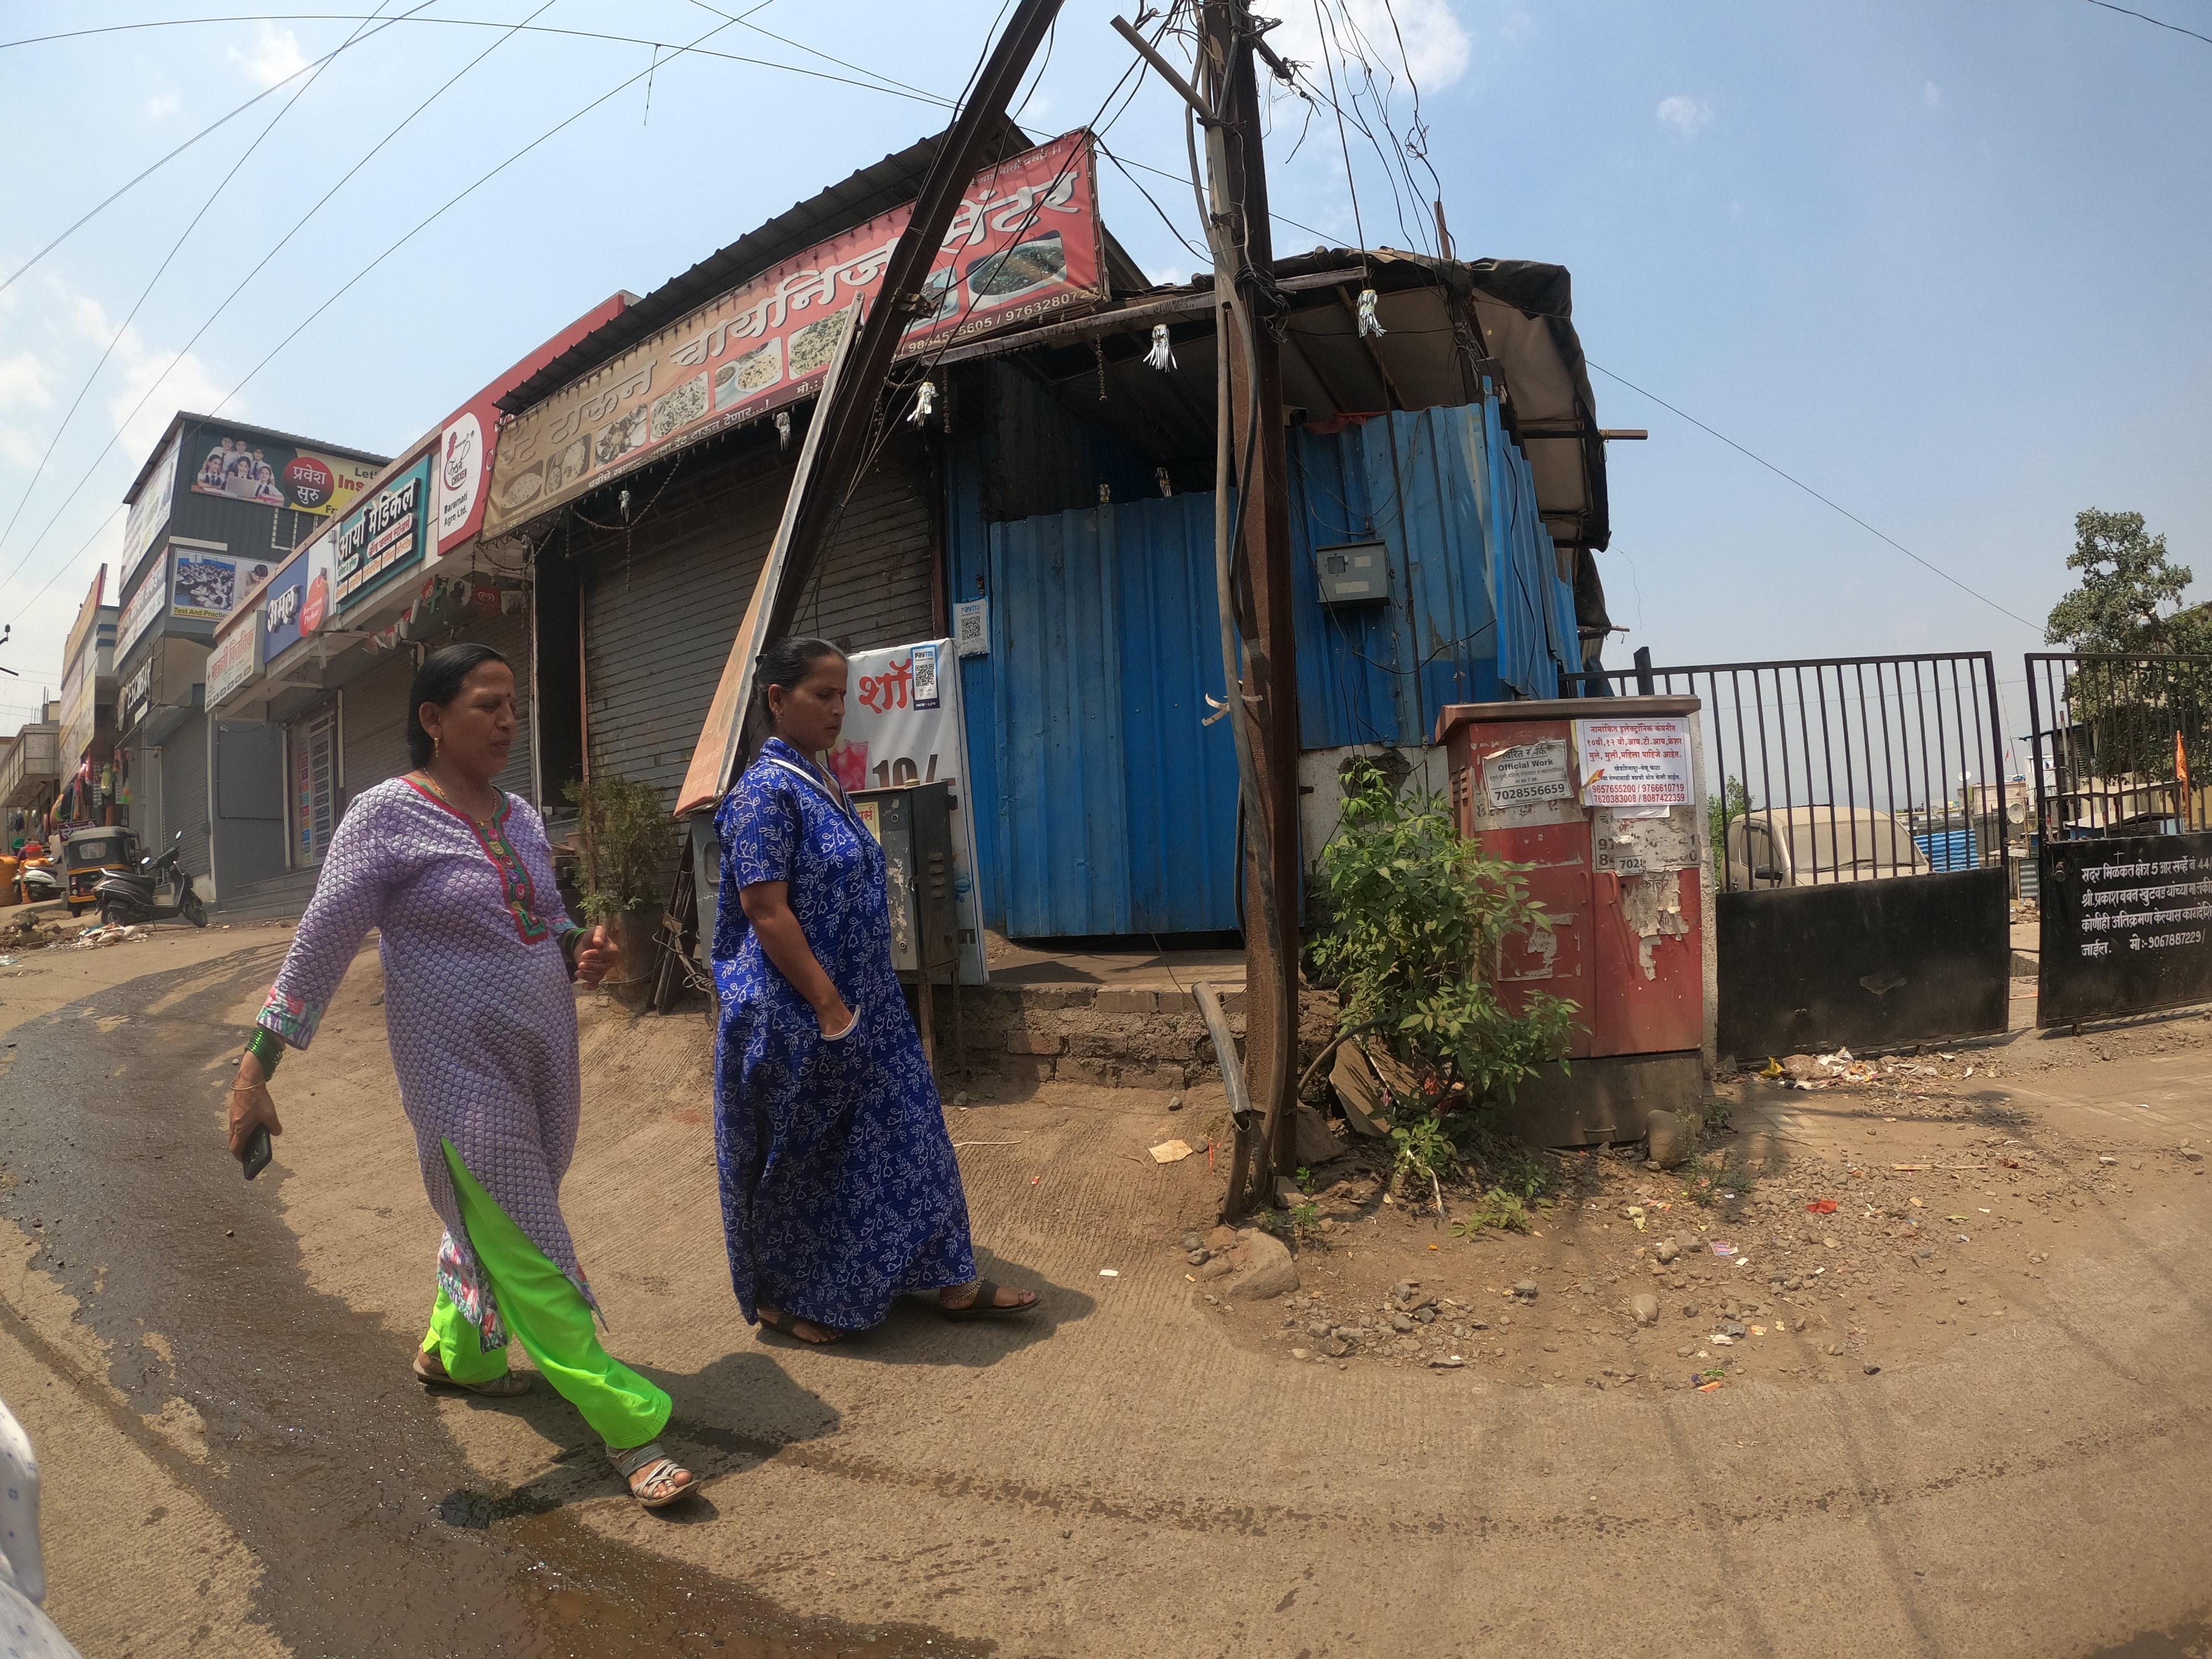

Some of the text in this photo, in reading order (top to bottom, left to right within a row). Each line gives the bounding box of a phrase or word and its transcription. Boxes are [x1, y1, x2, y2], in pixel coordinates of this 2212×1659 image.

[293, 464, 327, 485] प्रवेश
[354, 467, 378, 479] Let'
[451, 468, 468, 487] CHICKEN
[338, 474, 365, 492] Ins
[296, 486, 320, 504] सुरु
[444, 491, 468, 515] Baramati
[368, 478, 416, 535] मेडिकल
[444, 505, 468, 527] Agro Ltd.
[189, 608, 202, 617] And
[204, 610, 228, 619] Practic
[1589, 724, 1618, 733] नामांकित
[1654, 723, 1676, 732] कंपनीत
[1641, 749, 1661, 759] पाहिजे
[1498, 759, 1553, 771] Official Work
[1494, 784, 1565, 801] 7028556659
[1592, 784, 1636, 794] 9657655200
[1641, 783, 1685, 792] 9766610719
[1593, 794, 1637, 804] 7620383008
[1642, 794, 1686, 802] 8087422359
[2081, 867, 2102, 883] सदर
[2102, 862, 2135, 880] मिळकत
[2135, 858, 2150, 879] क्षेत्र
[2151, 862, 2158, 875] 5
[2120, 889, 2138, 905] बबन
[2081, 911, 2111, 933] कोणीही
[2111, 909, 2153, 928] अतिक्रमण
[2153, 907, 2183, 925] केल्यास
